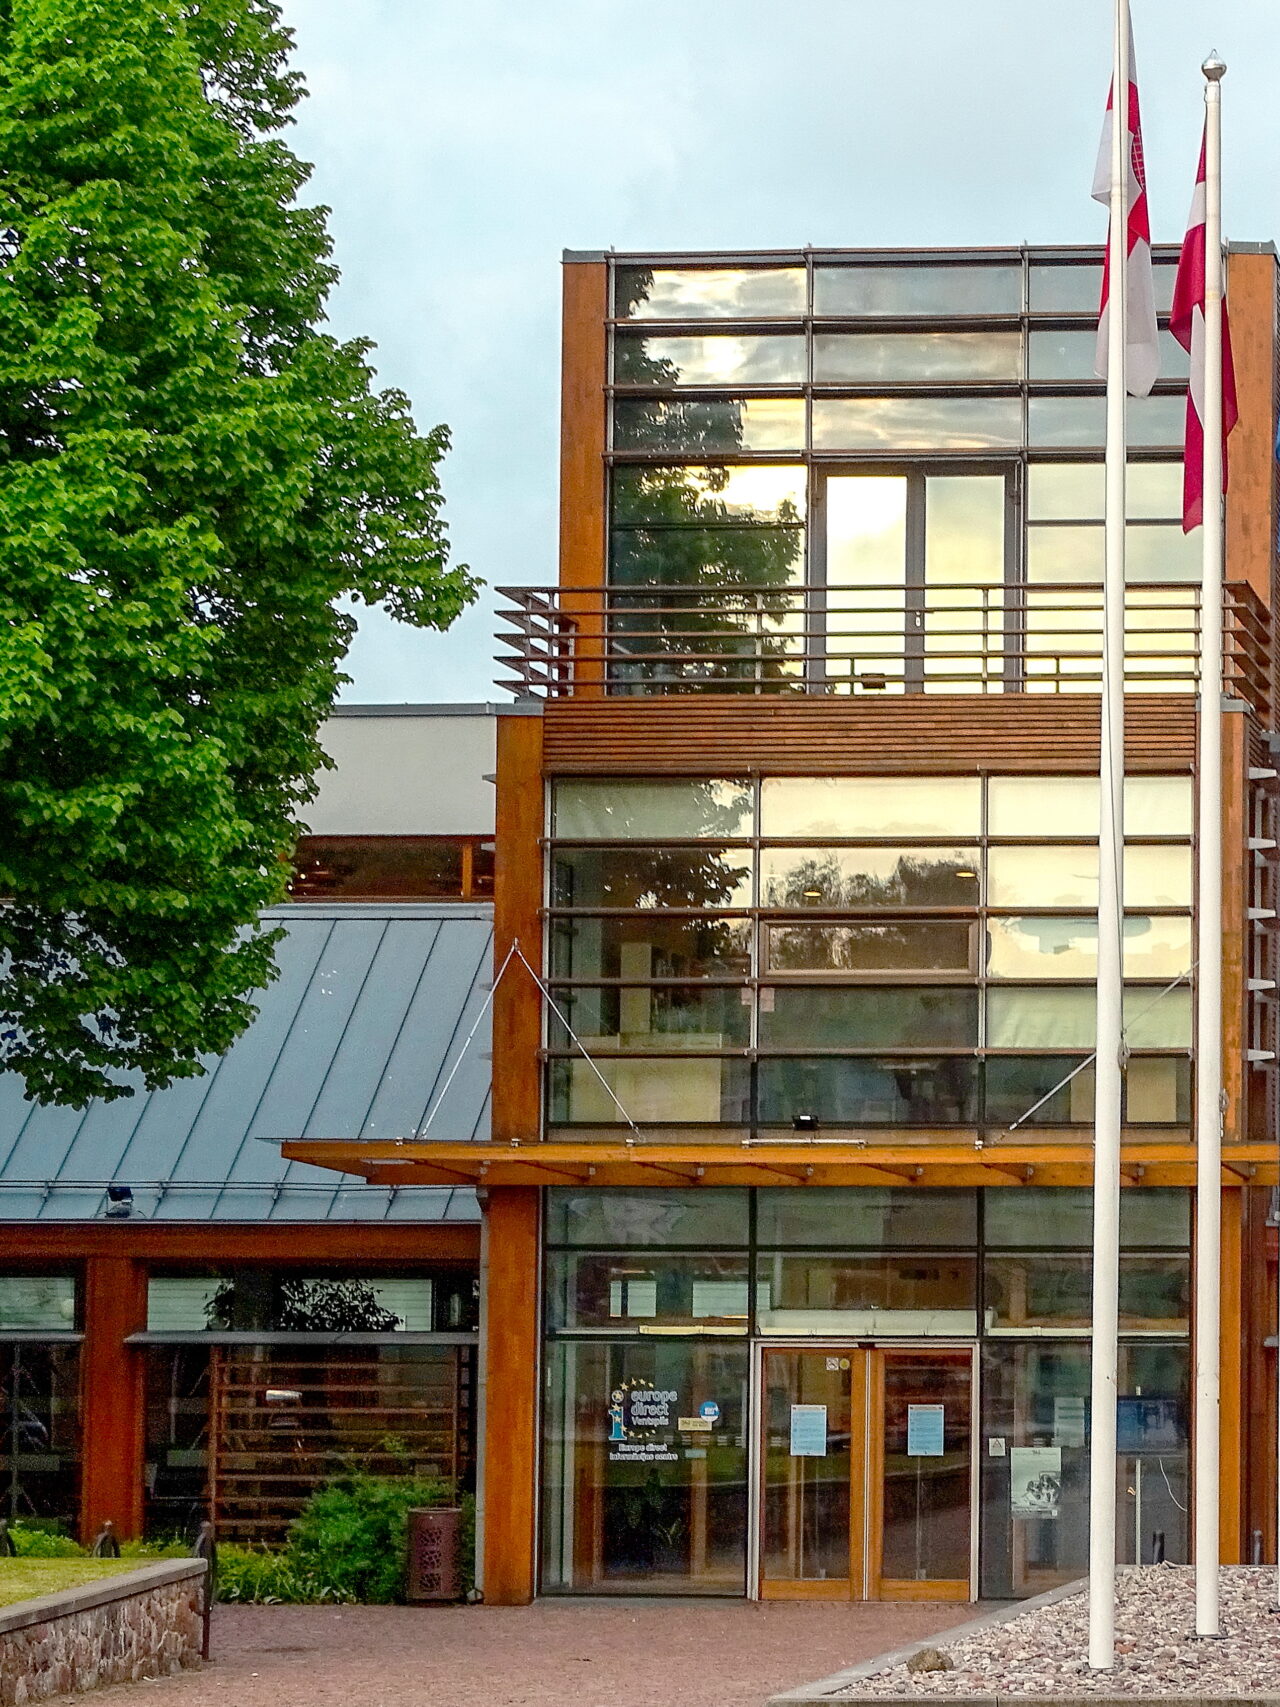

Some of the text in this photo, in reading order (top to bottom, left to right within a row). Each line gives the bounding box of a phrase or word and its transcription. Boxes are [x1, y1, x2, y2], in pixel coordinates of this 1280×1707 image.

[631, 1391, 678, 1405] europe
[631, 1402, 670, 1416] direct
[631, 1416, 669, 1427] Ventspils
[618, 1443, 668, 1453] Europe direct
